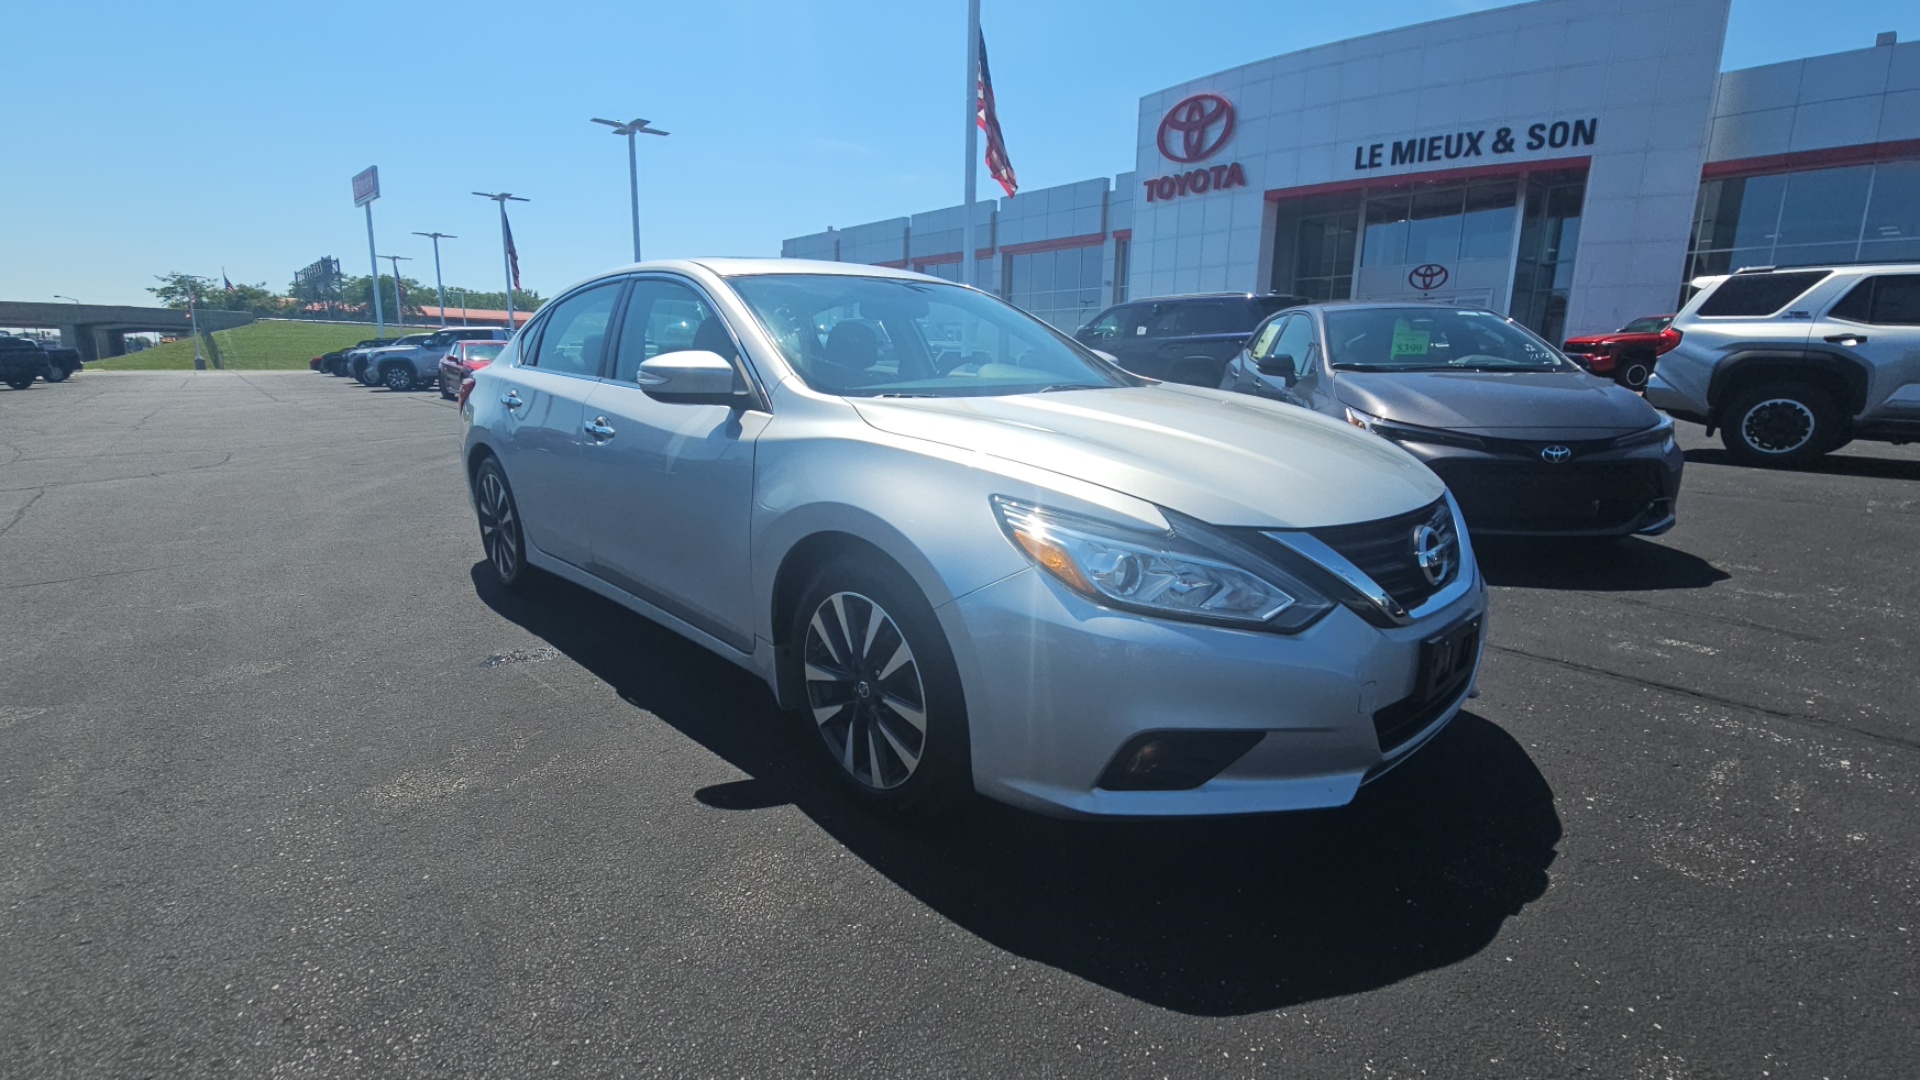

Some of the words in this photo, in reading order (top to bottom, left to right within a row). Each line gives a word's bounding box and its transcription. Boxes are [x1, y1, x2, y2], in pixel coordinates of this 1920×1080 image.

[1355, 145, 1383, 170] LE
[1390, 131, 1485, 166] MIEUX
[1491, 127, 1515, 154] &
[1526, 118, 1597, 151] SON
[1144, 162, 1245, 202] TOYOTA
